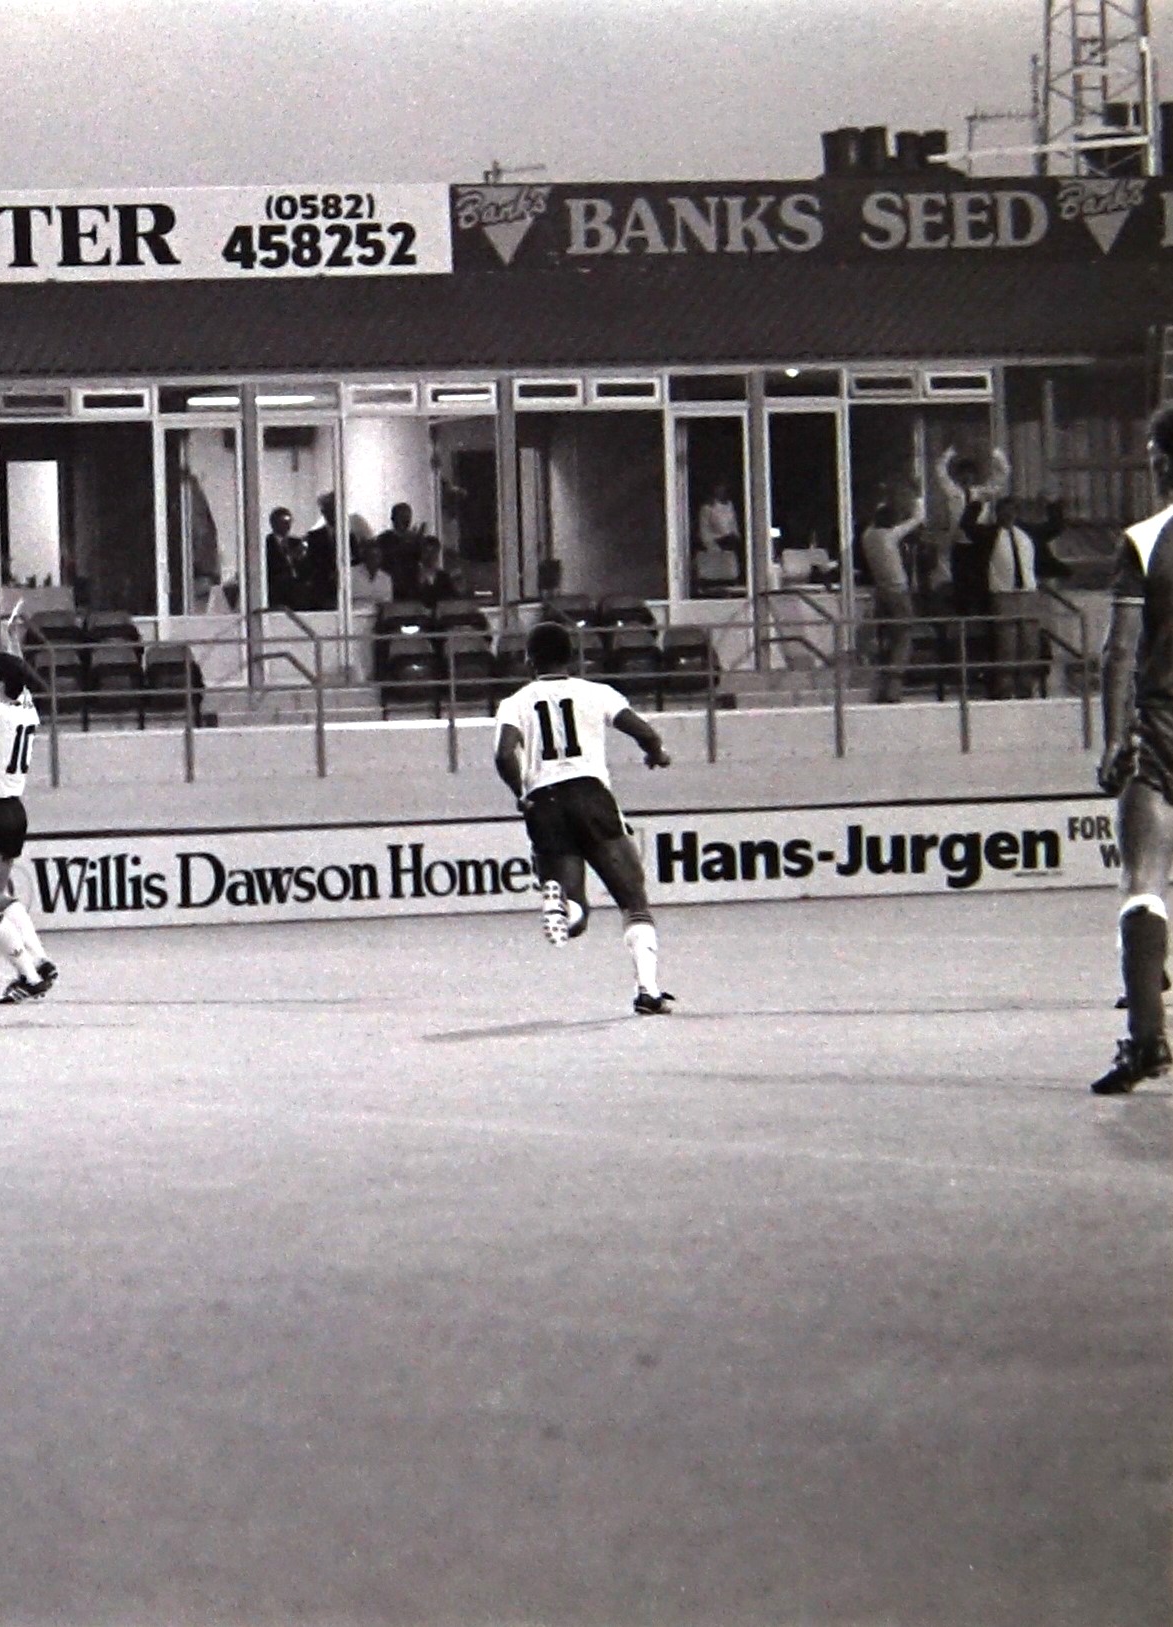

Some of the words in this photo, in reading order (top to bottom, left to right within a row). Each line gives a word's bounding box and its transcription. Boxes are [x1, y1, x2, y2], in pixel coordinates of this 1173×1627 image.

[266, 193, 375, 221] (0582)
[564, 194, 825, 256] BANKS
[860, 191, 1049, 251] SEED
[222, 222, 417, 270] 458252
[534, 698, 583, 761] 11
[657, 825, 1061, 889] Hans-Jurgen
[1068, 815, 1112, 840] FOR
[31, 854, 168, 913] Willis
[176, 852, 378, 908] Dawson
